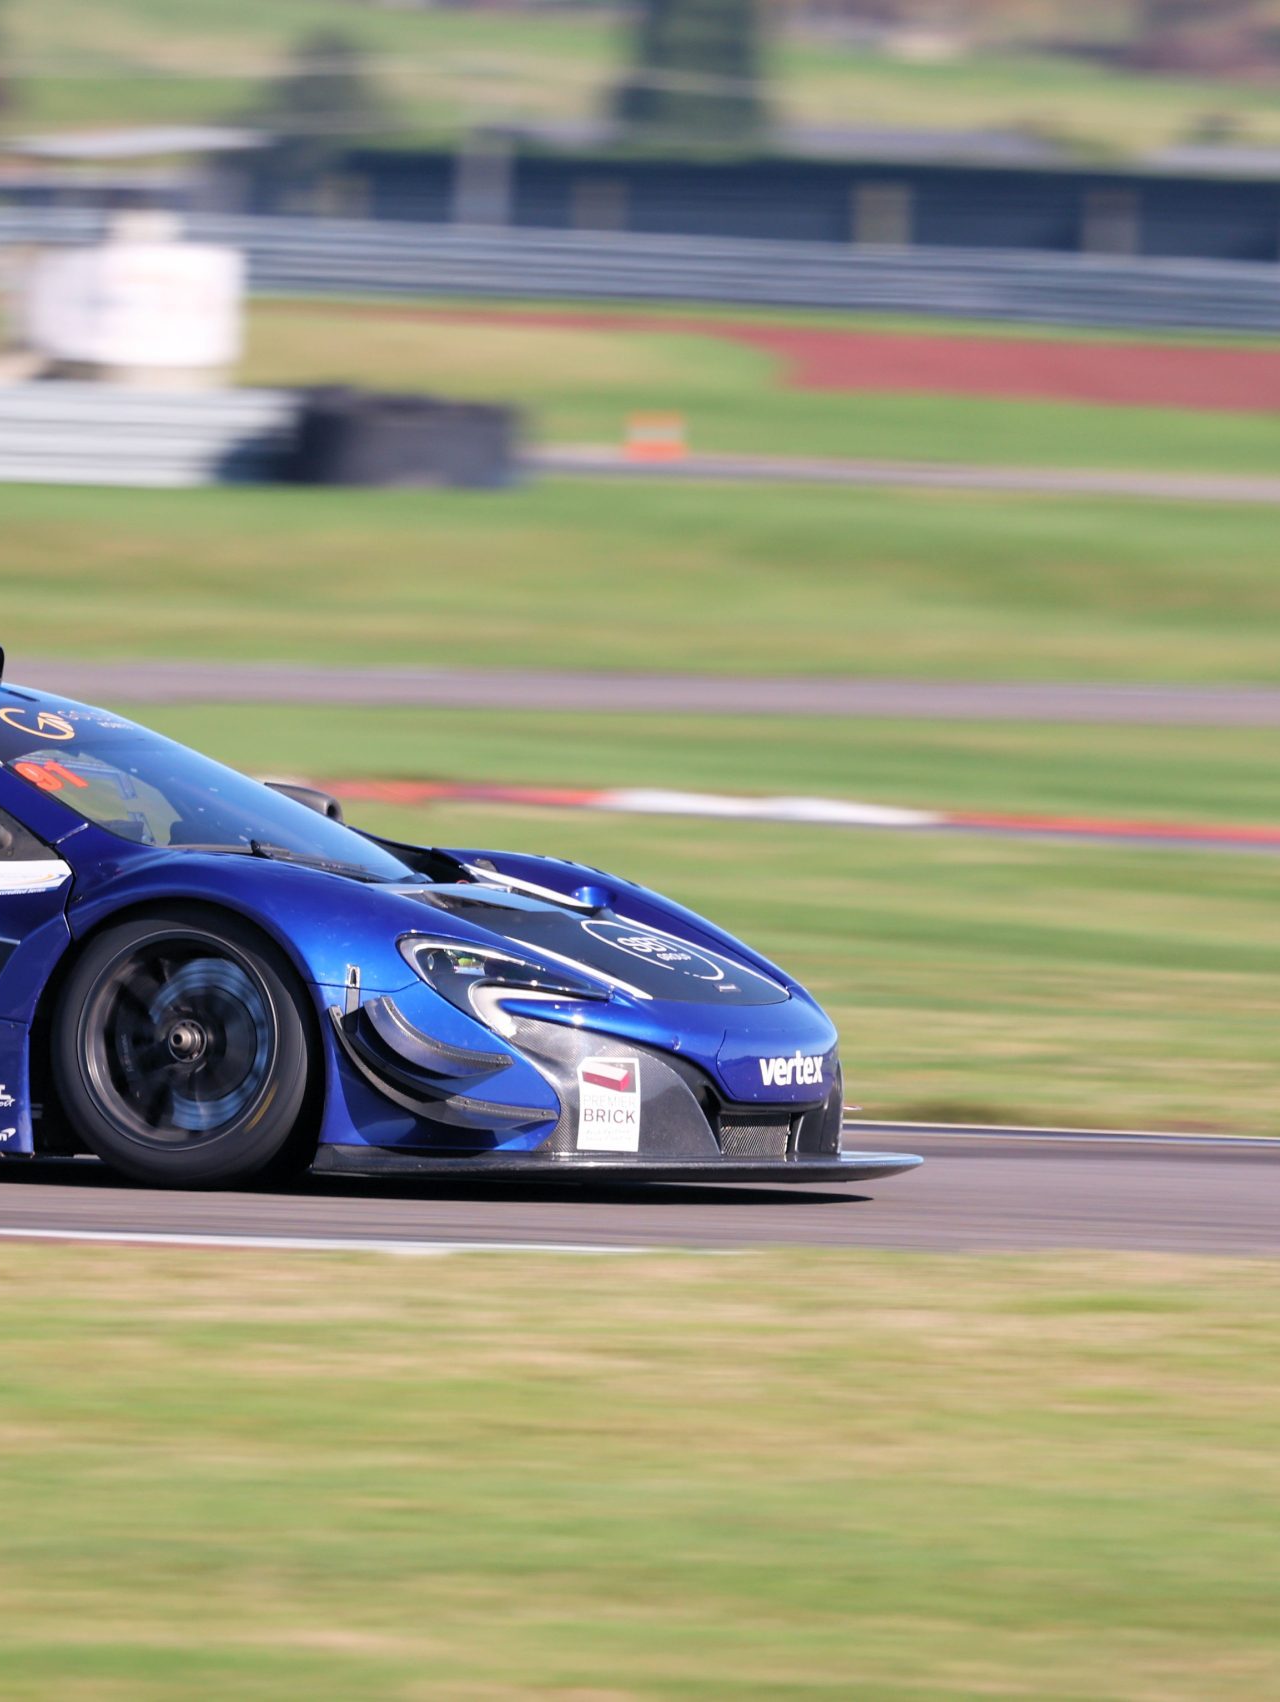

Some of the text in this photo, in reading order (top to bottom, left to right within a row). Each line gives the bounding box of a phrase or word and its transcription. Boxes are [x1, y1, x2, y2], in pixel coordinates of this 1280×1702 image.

[14, 759, 89, 792] 91
[759, 1050, 823, 1086] vertex
[584, 1108, 635, 1124] BRICK
